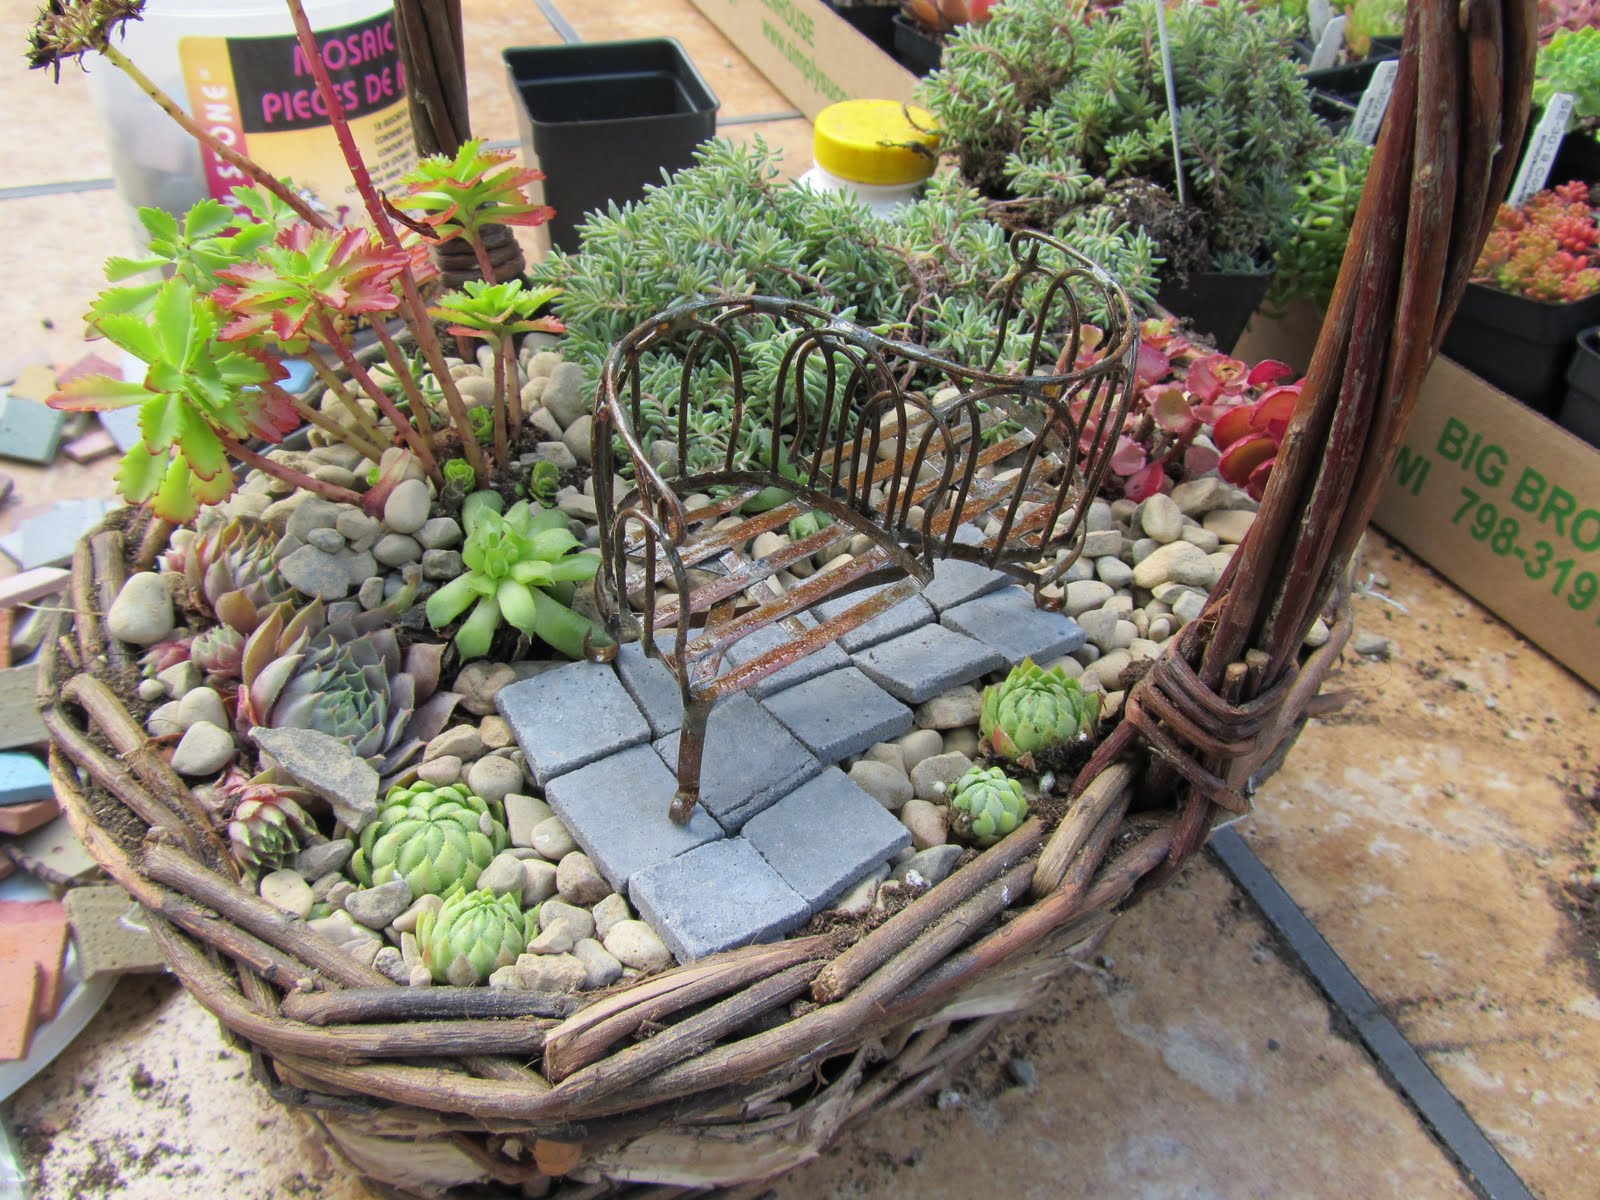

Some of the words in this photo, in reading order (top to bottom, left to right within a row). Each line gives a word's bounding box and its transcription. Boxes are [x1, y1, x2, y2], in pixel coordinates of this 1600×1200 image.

[364, 66, 394, 104] DE
[201, 84, 245, 180] SONE
[1436, 416, 1509, 488] BIG
[1452, 485, 1600, 617] 798-319
